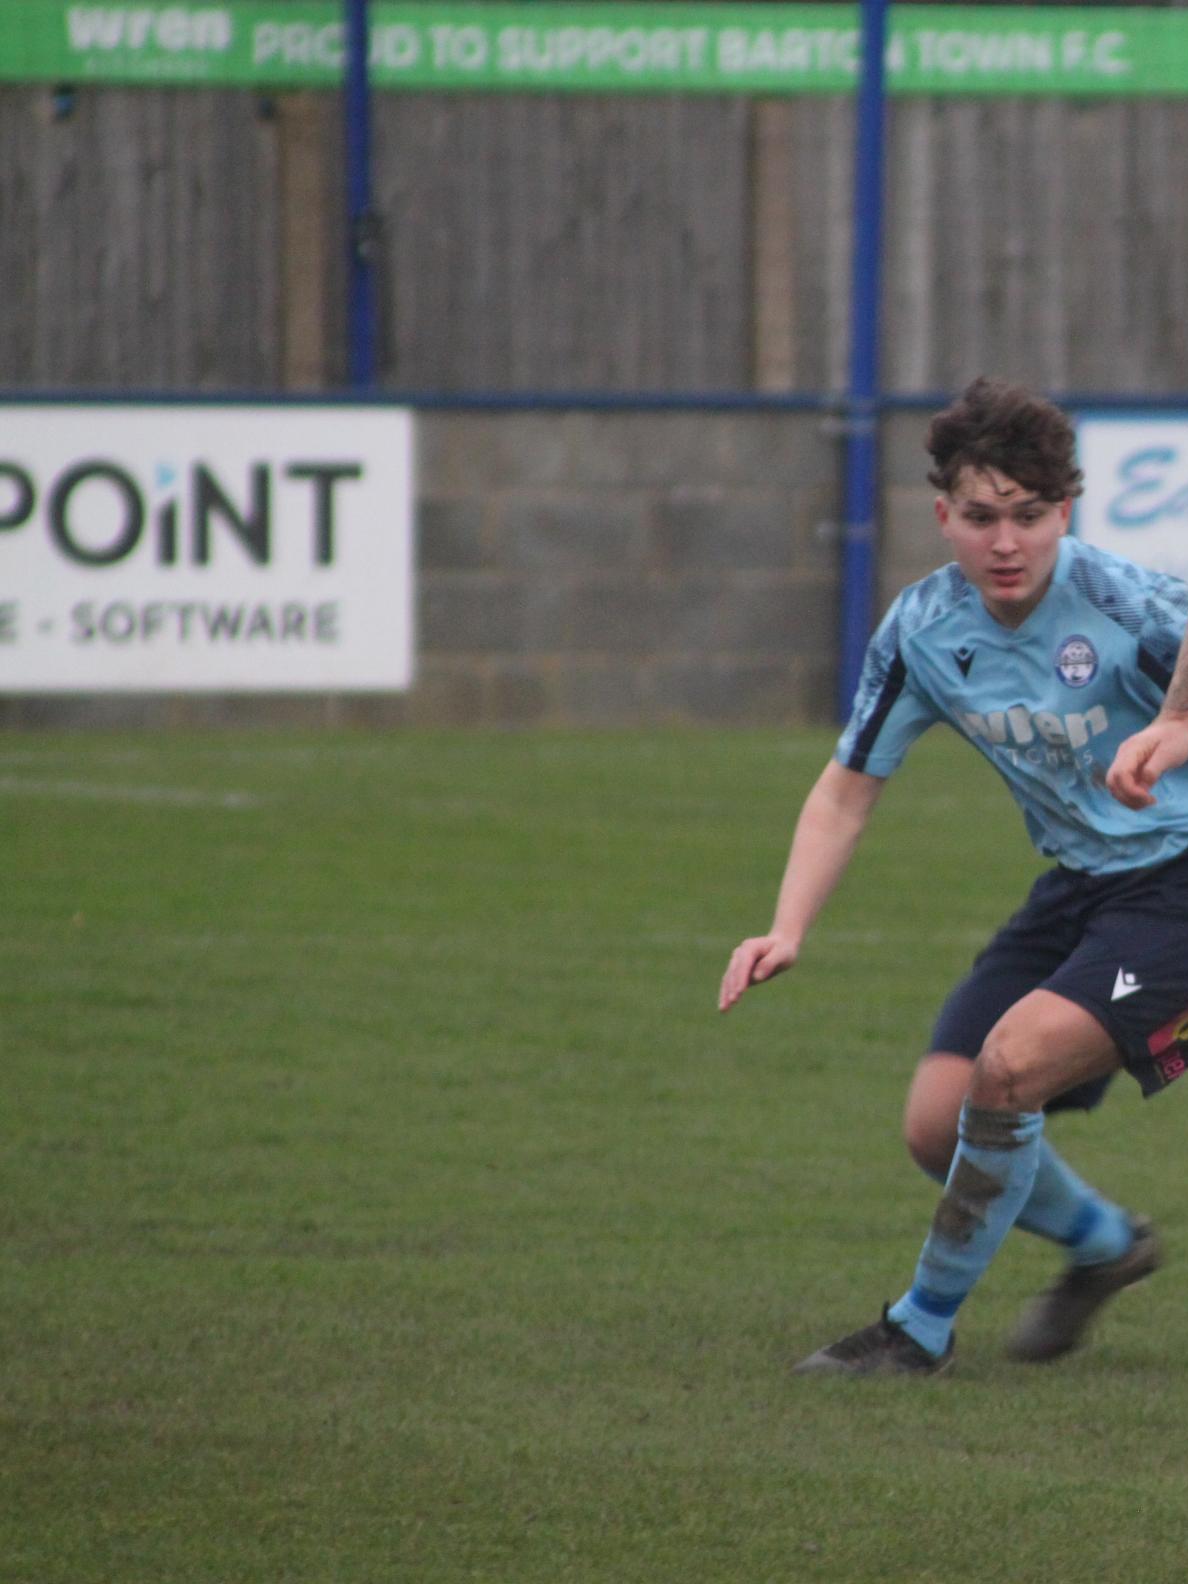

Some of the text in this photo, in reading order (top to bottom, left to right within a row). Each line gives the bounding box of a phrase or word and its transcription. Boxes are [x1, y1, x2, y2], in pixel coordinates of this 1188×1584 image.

[67, 9, 232, 51] wren
[428, 26, 489, 70] TO
[497, 27, 707, 71] SUPPORT
[912, 30, 1054, 72] TOWN
[70, 603, 338, 644] SOFTWARE
[963, 703, 1108, 749] wren
